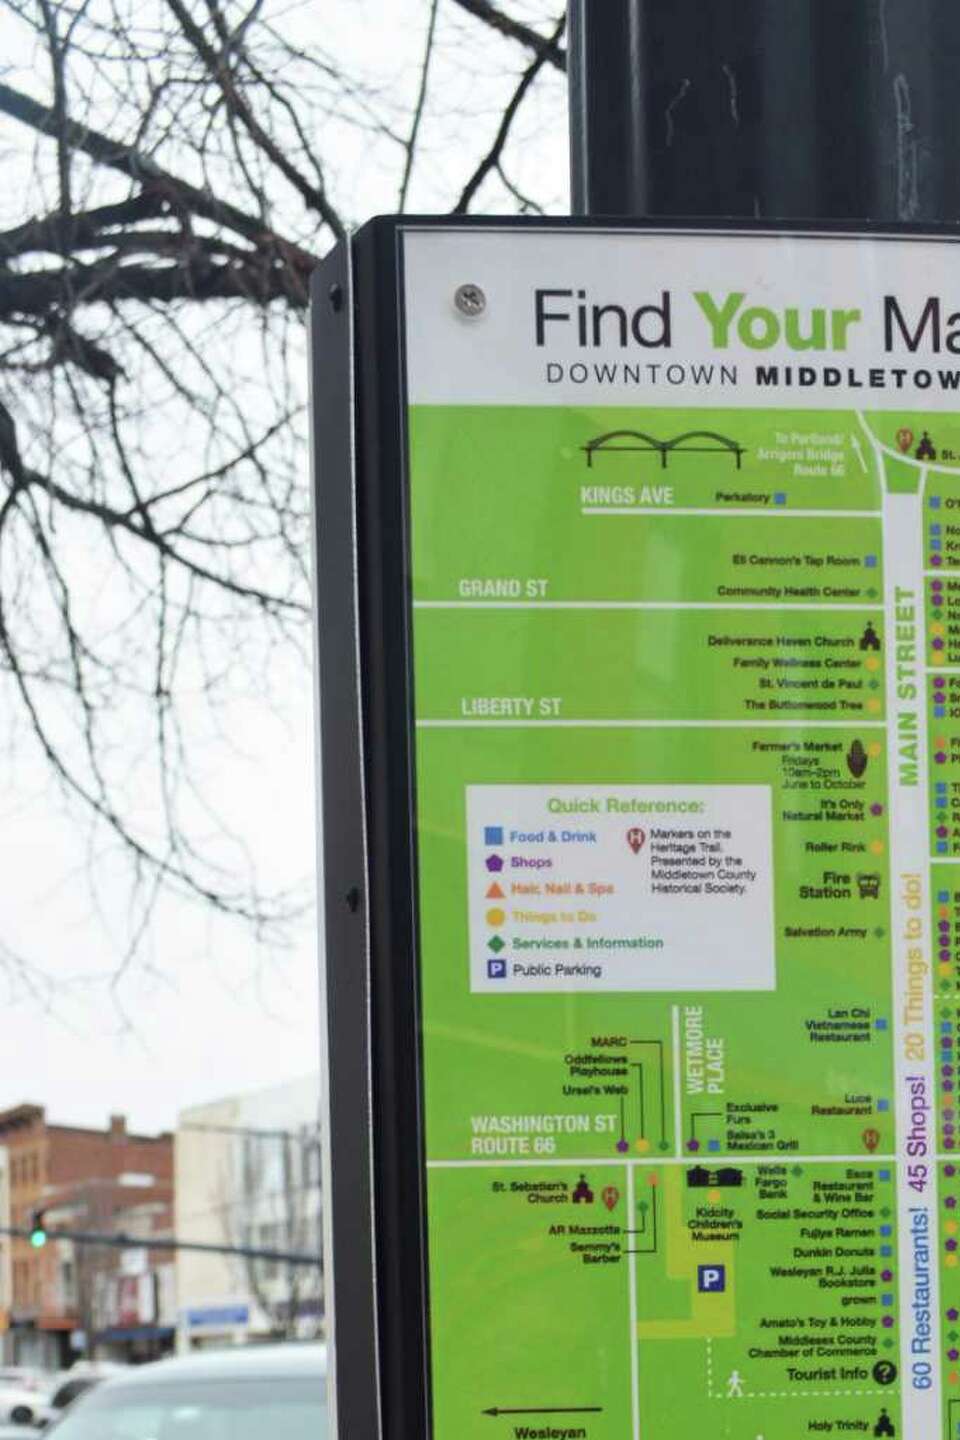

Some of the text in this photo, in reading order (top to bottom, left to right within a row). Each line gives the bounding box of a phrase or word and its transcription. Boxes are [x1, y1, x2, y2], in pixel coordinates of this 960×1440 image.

[534, 289, 672, 349] Find
[695, 292, 859, 351] Your
[546, 363, 738, 386] DOWNTOWN
[581, 487, 673, 504] KINGS AVE
[459, 581, 548, 597] GRAND ST
[718, 586, 860, 599] Community Health Center
[897, 587, 918, 786] MAIN STREET
[462, 699, 561, 715] LIBERTY ST
[548, 798, 704, 814] Quick Reference:
[510, 831, 597, 843] Food & Drink
[650, 829, 694, 838] Markers
[713, 830, 731, 838] the
[651, 843, 696, 854] Heritage
[806, 842, 865, 853] Roller Rink
[511, 856, 552, 868] Shops
[651, 856, 742, 868] Presented by the
[651, 869, 756, 881] Middletown County
[824, 873, 850, 886] Fire
[545, 883, 570, 894] Nail
[574, 883, 583, 894] &
[588, 883, 614, 896] Spa
[652, 883, 701, 893] Historical
[800, 886, 851, 900] Station
[513, 911, 595, 925] Things to Do
[904, 916, 920, 940] to
[512, 937, 663, 949] Services & Information
[513, 964, 602, 978] Public Parking
[904, 952, 928, 1026] Things
[686, 1007, 702, 1094] WETMORE
[906, 1034, 924, 1060] 20
[707, 1038, 724, 1093] PLACE
[471, 1114, 616, 1132] WASHINGTON ST
[907, 1077, 930, 1192] 45 Shops!
[472, 1137, 555, 1154] ROUTE 66
[691, 1231, 739, 1242] Museum
[910, 1208, 931, 1389] 60 Restaurants!
[787, 1367, 868, 1381] Tourist Info
[514, 1427, 585, 1440] Wesleyan
